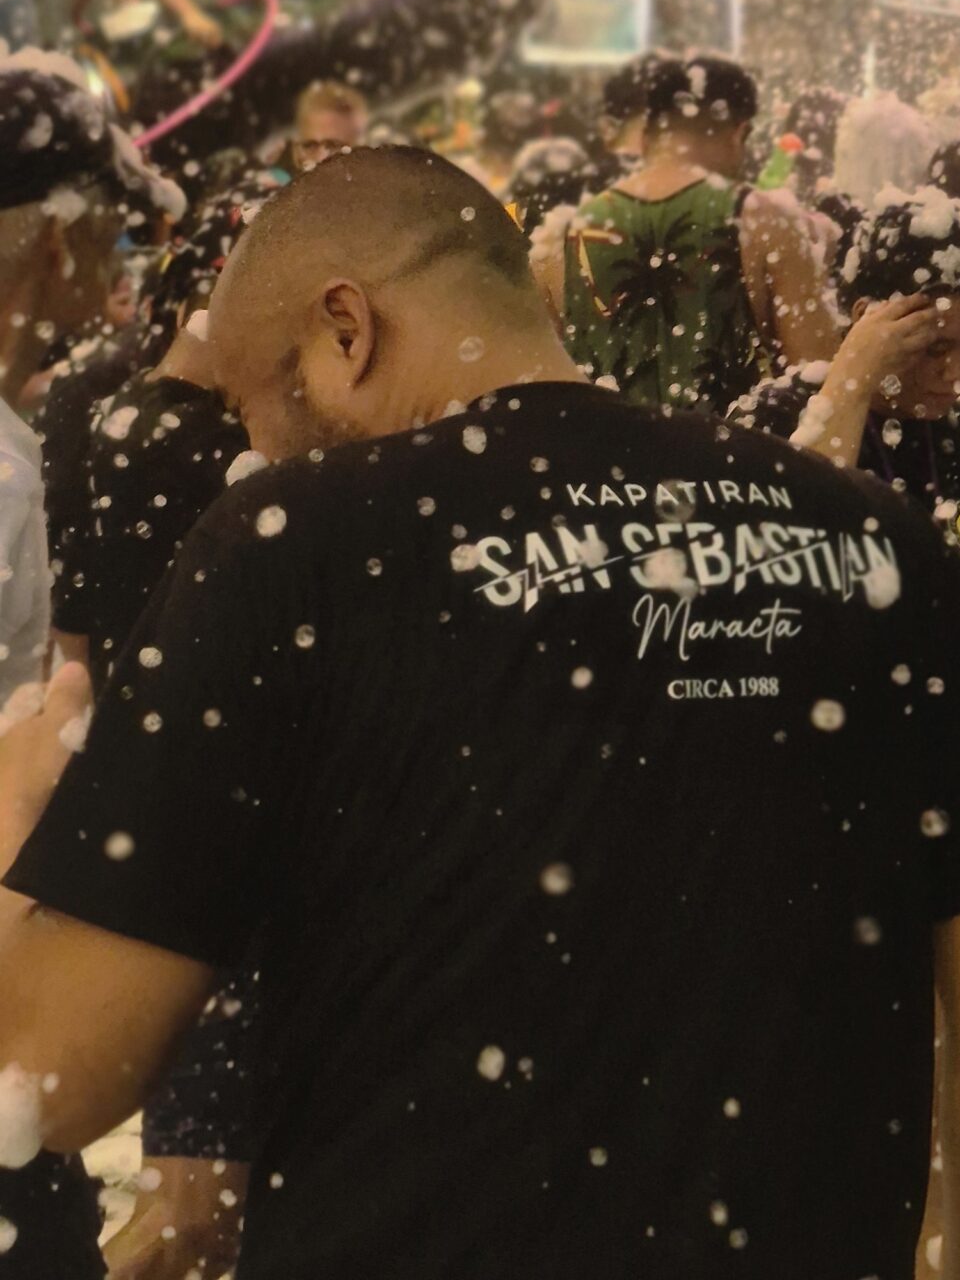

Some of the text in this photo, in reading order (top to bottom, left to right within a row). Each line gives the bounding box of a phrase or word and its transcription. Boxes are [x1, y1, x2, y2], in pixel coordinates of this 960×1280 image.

[566, 480, 792, 510] KAPATIRAN
[475, 524, 616, 613] SAN
[632, 593, 802, 661] Maracta
[667, 676, 779, 699] CIRCA 1988
